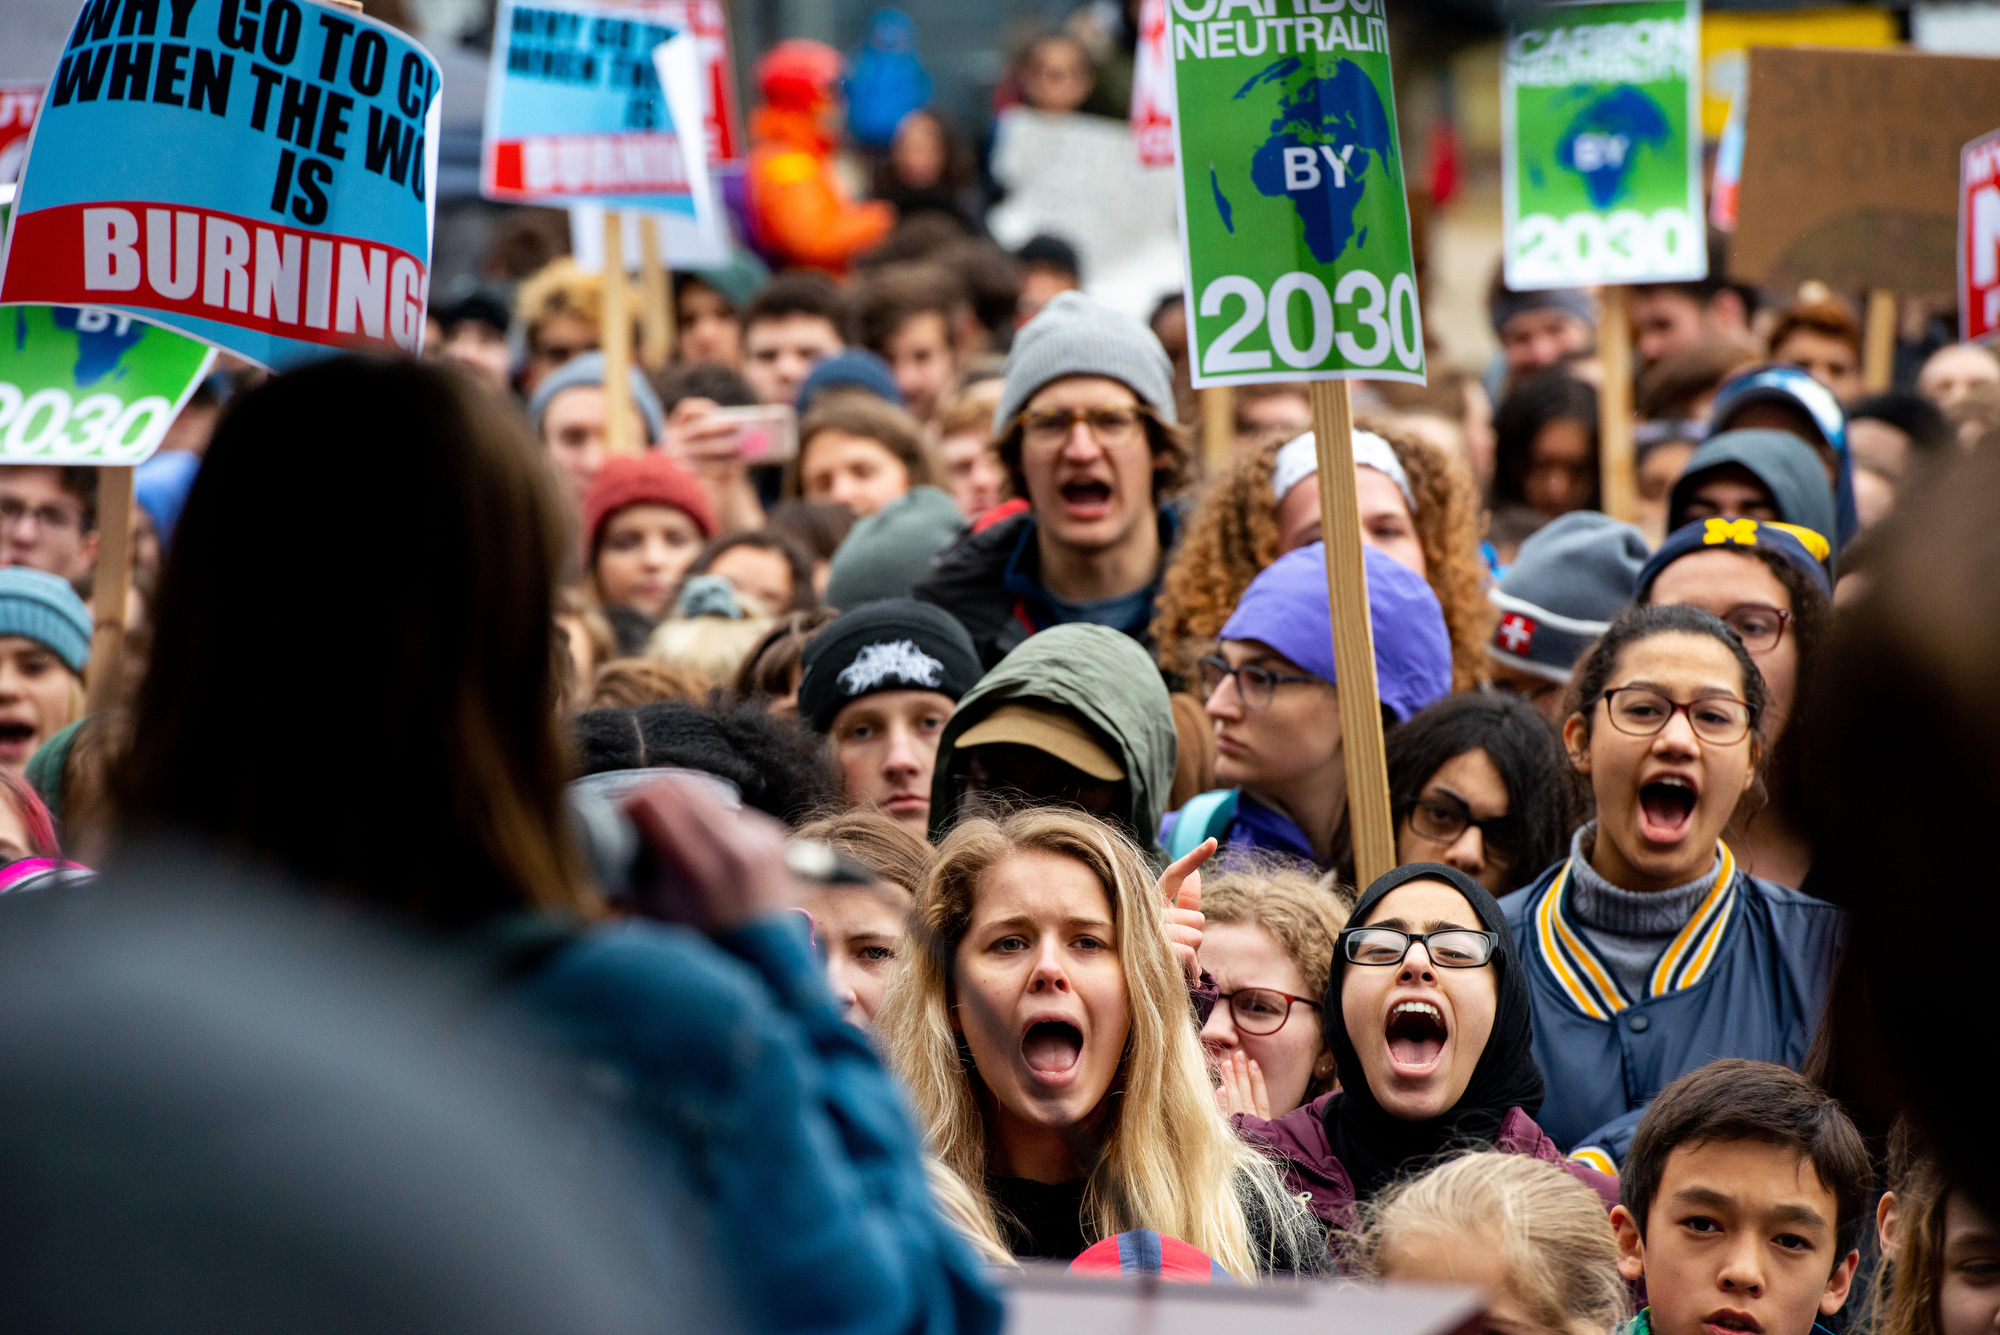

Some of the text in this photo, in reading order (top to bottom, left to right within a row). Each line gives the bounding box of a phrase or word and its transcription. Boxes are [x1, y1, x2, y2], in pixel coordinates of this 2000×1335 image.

[70, 0, 197, 50] WHY
[218, 0, 303, 66] GO
[319, 12, 388, 97] TO
[52, 40, 235, 118] WHEN
[250, 62, 355, 162] THE
[270, 147, 334, 227] IS
[1282, 144, 1355, 190] BY
[83, 206, 427, 355] BURNING
[1513, 208, 1697, 279] 2030
[1199, 269, 1423, 374] 2030
[1703, 517, 1758, 546] M
